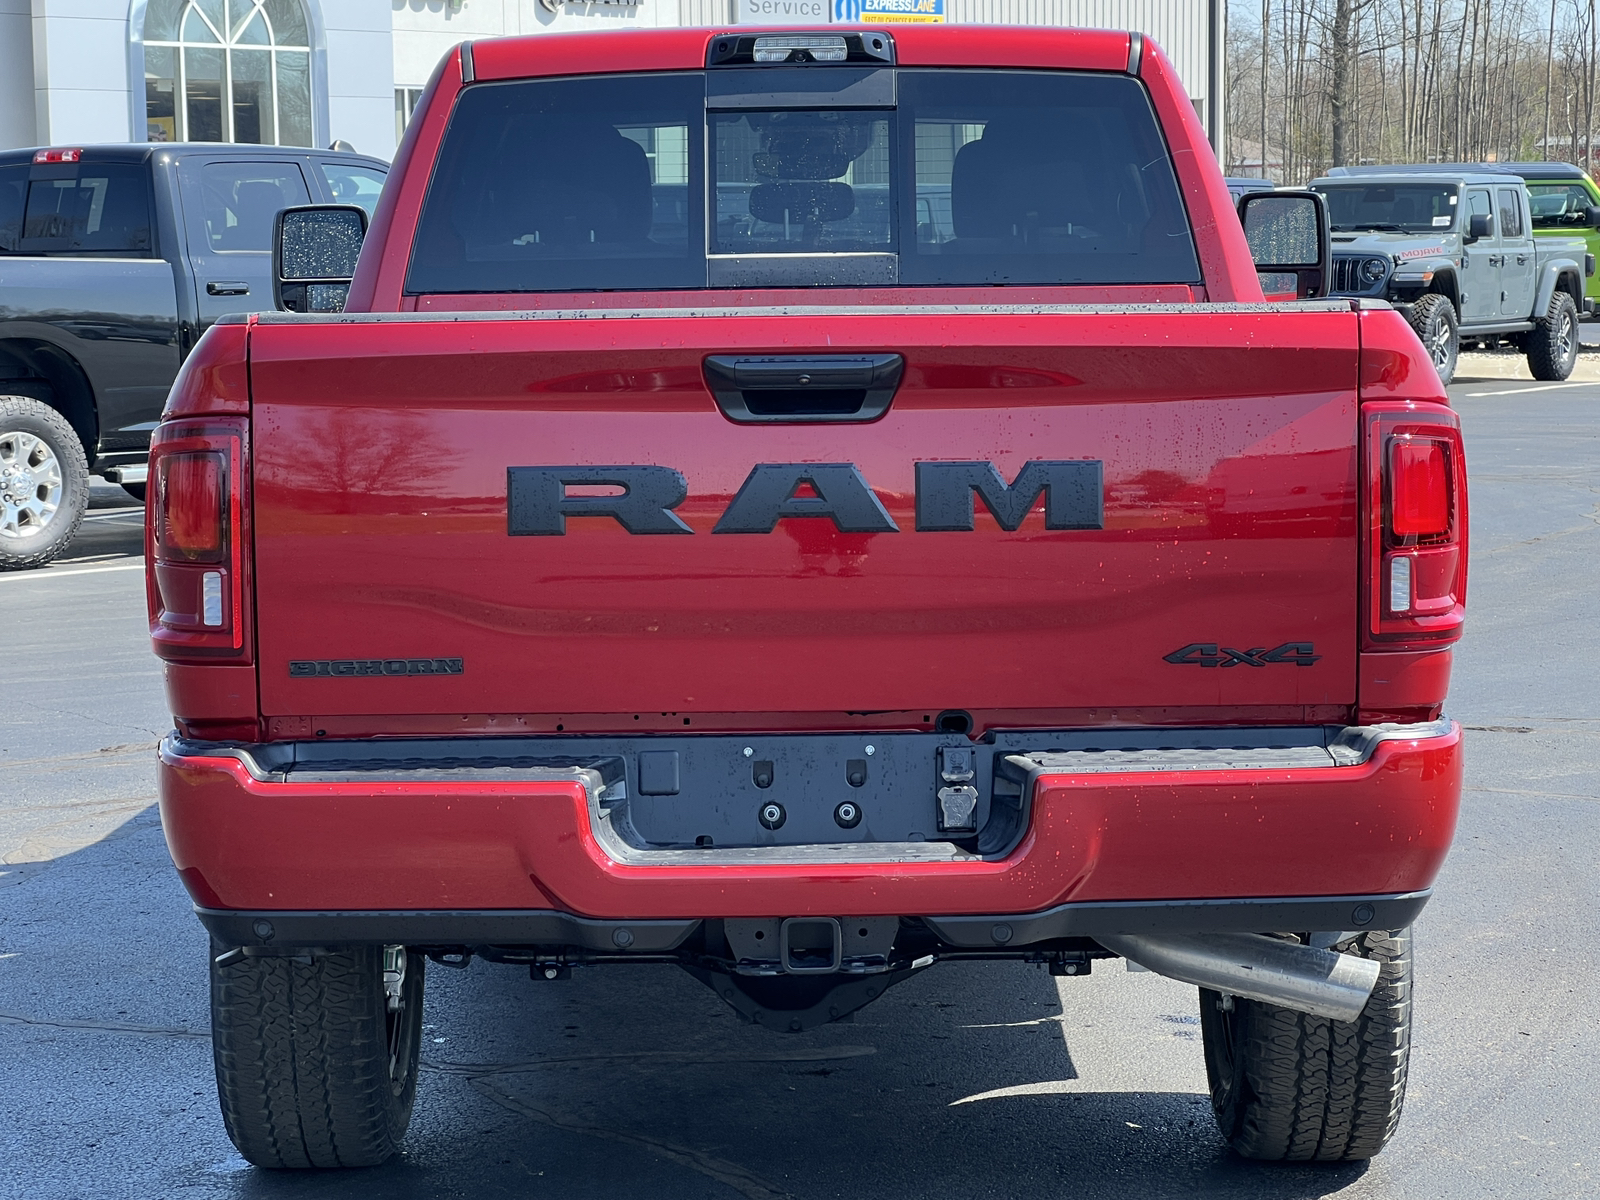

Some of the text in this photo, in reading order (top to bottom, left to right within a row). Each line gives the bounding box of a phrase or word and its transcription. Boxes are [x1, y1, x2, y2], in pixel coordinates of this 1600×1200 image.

[749, 0, 821, 16] Service
[1401, 246, 1442, 258] MOJAVE
[507, 460, 1105, 536] RAM
[289, 657, 464, 678] BIGHORN
